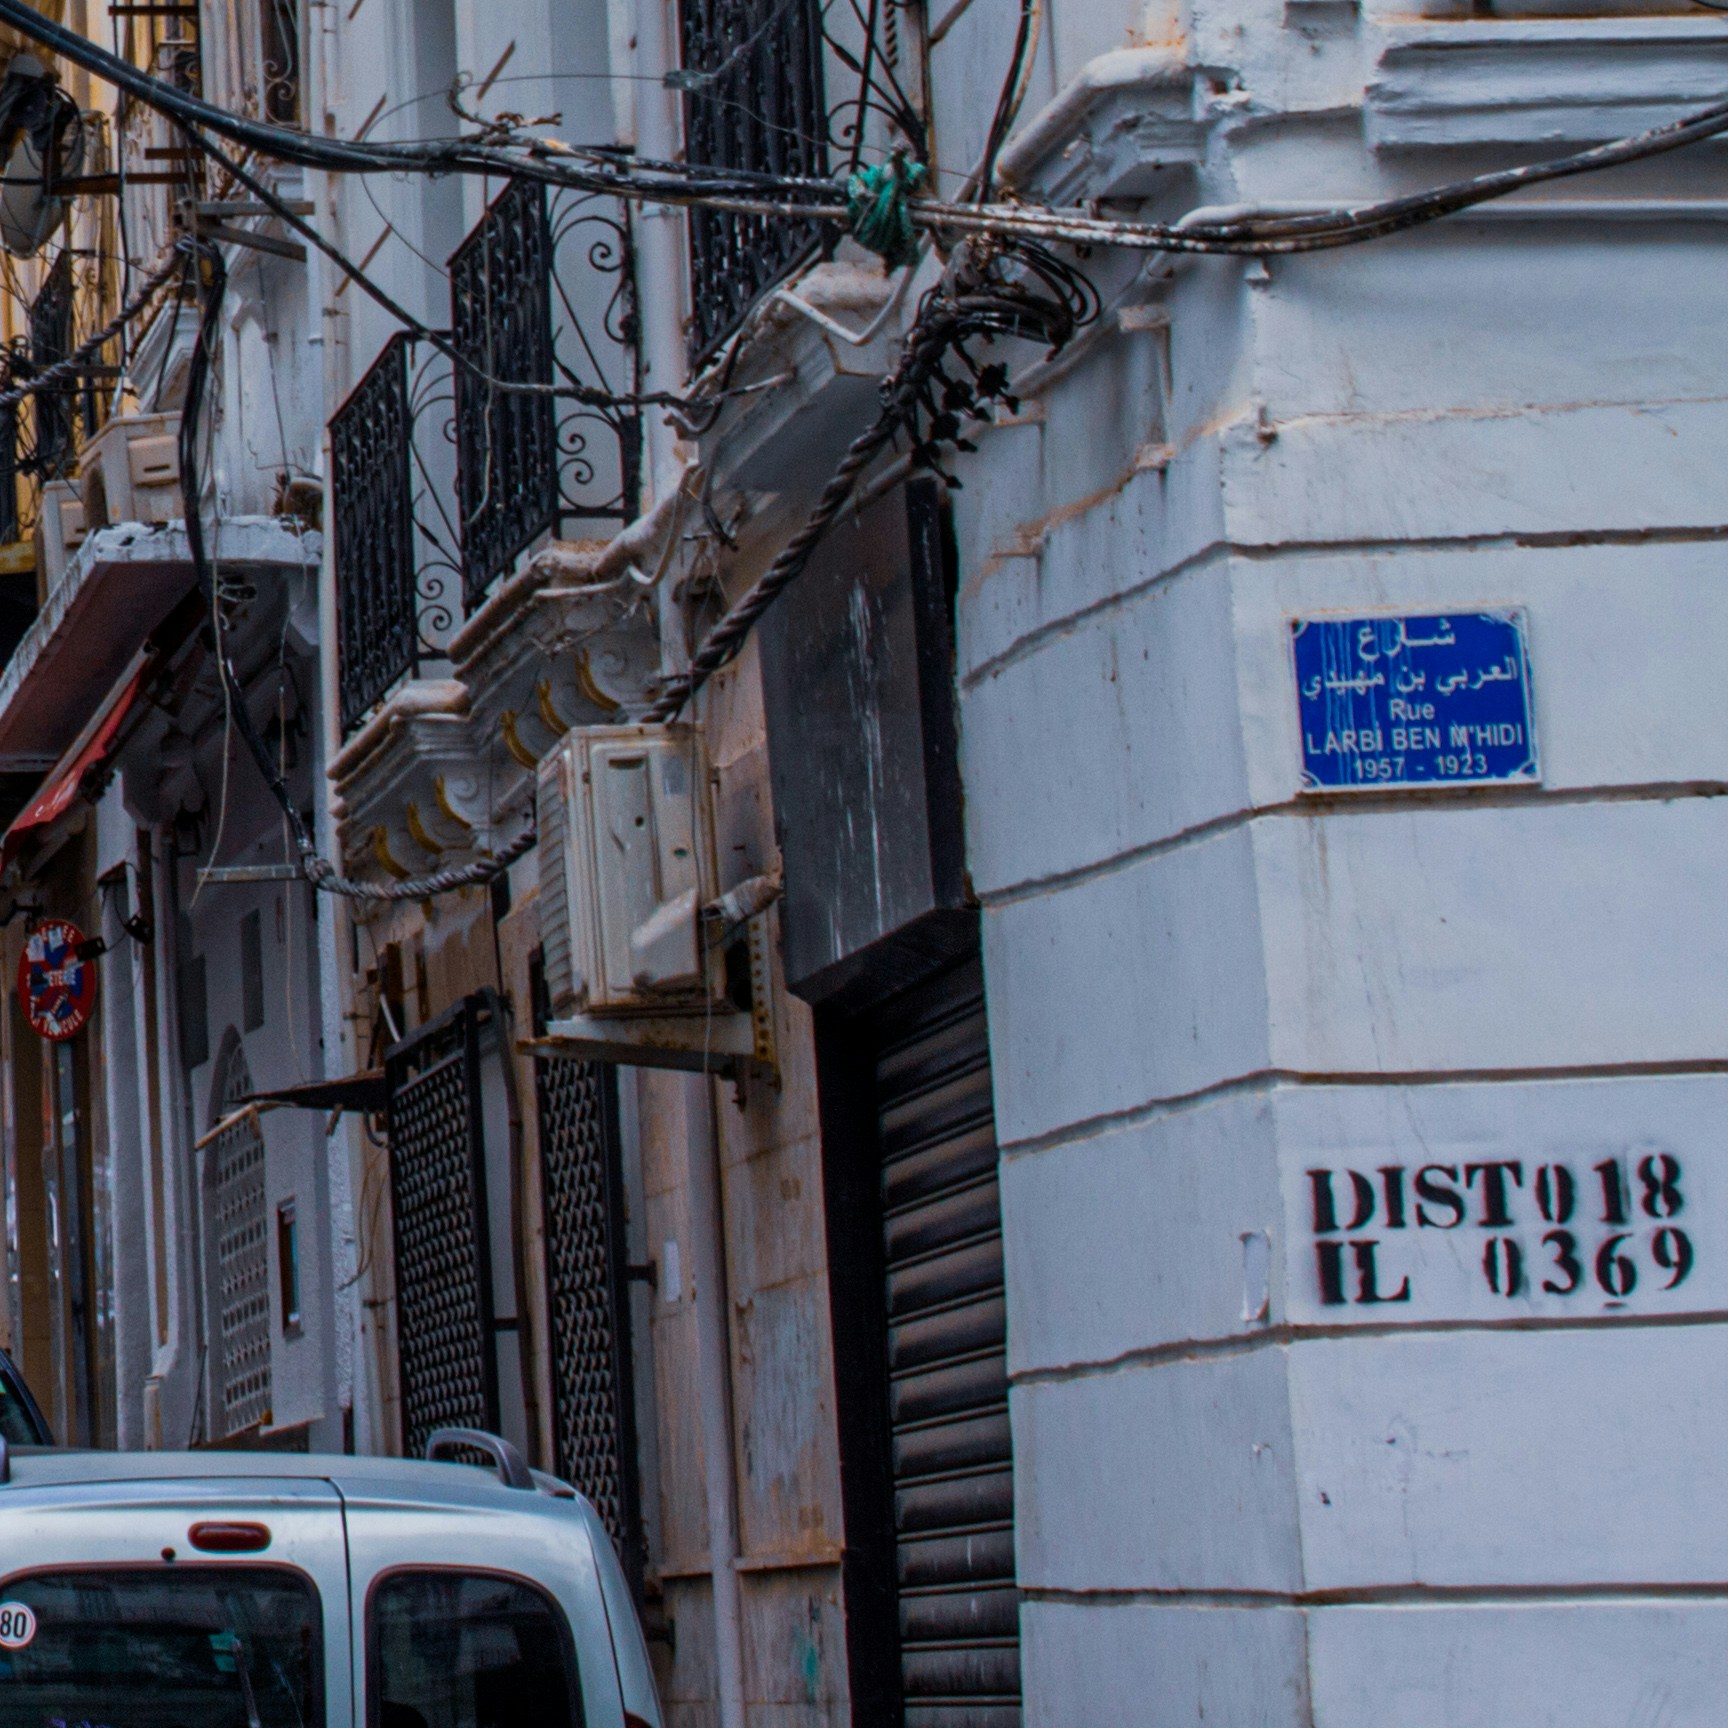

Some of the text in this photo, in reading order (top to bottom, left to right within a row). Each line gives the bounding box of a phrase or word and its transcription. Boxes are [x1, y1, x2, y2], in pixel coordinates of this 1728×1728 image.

[1357, 617, 1456, 661] شارع
[1396, 665, 1426, 693] بن
[1436, 656, 1518, 696] العربي
[1389, 698, 1435, 720] Rue
[1306, 723, 1523, 755] LARBI BEN M'HIDI
[1354, 757, 1405, 779] 1957
[1436, 754, 1488, 776] 1923
[1314, 1226, 1694, 1305] IL 0369
[0, 1610, 27, 1639] 80
